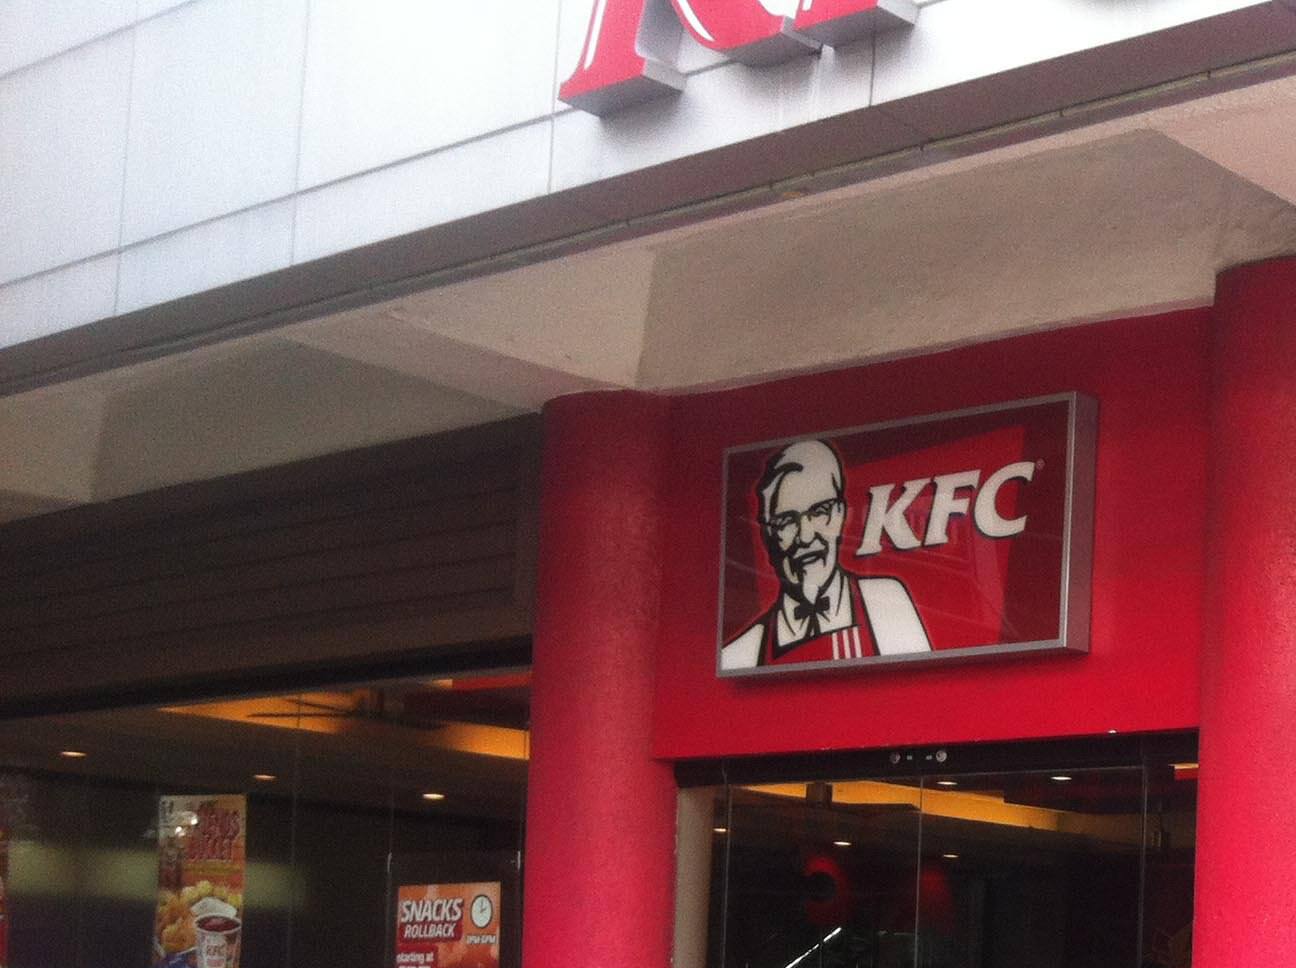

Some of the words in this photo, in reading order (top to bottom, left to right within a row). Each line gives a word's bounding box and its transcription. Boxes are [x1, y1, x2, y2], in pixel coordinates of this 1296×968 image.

[856, 461, 1036, 557] KFC
[400, 898, 464, 922] SNACKS
[403, 922, 457, 939] ROLLBACK
